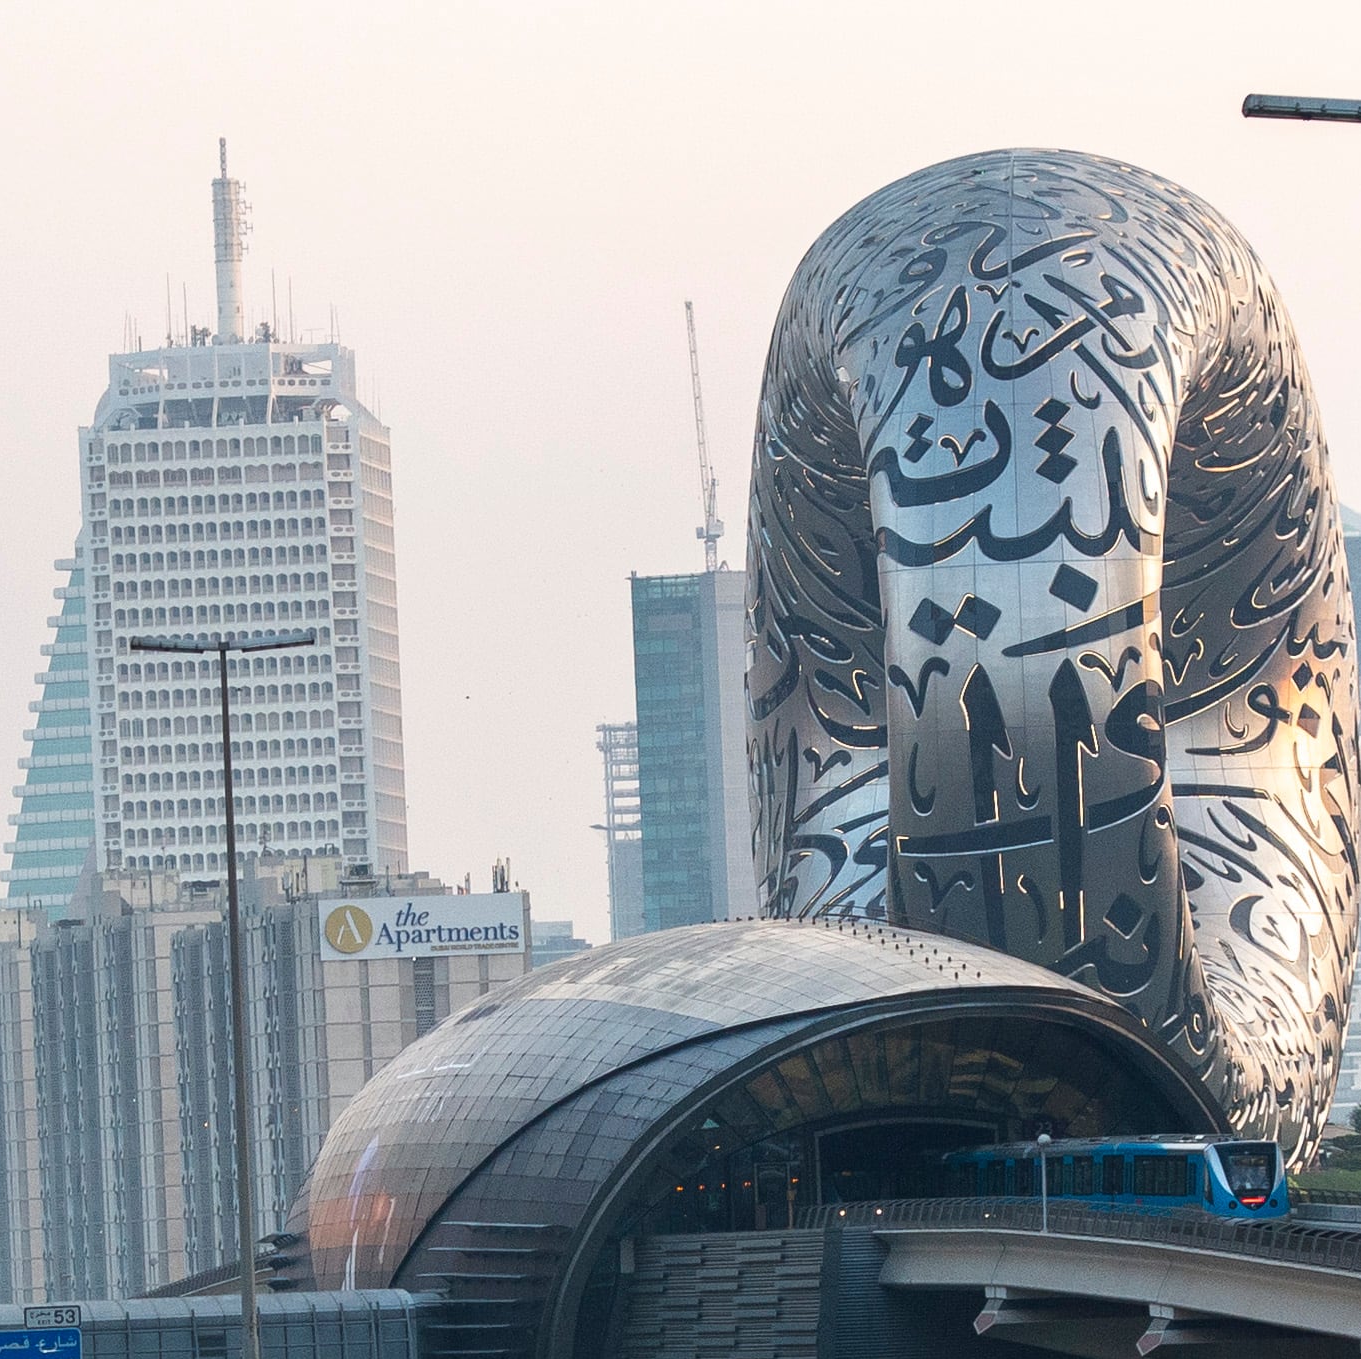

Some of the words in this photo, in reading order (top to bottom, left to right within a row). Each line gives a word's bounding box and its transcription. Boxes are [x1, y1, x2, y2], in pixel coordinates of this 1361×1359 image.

[395, 903, 429, 927] the
[375, 922, 519, 952] Apartments
[54, 1310, 76, 1324] 53
[39, 1335, 78, 1353] شارع
